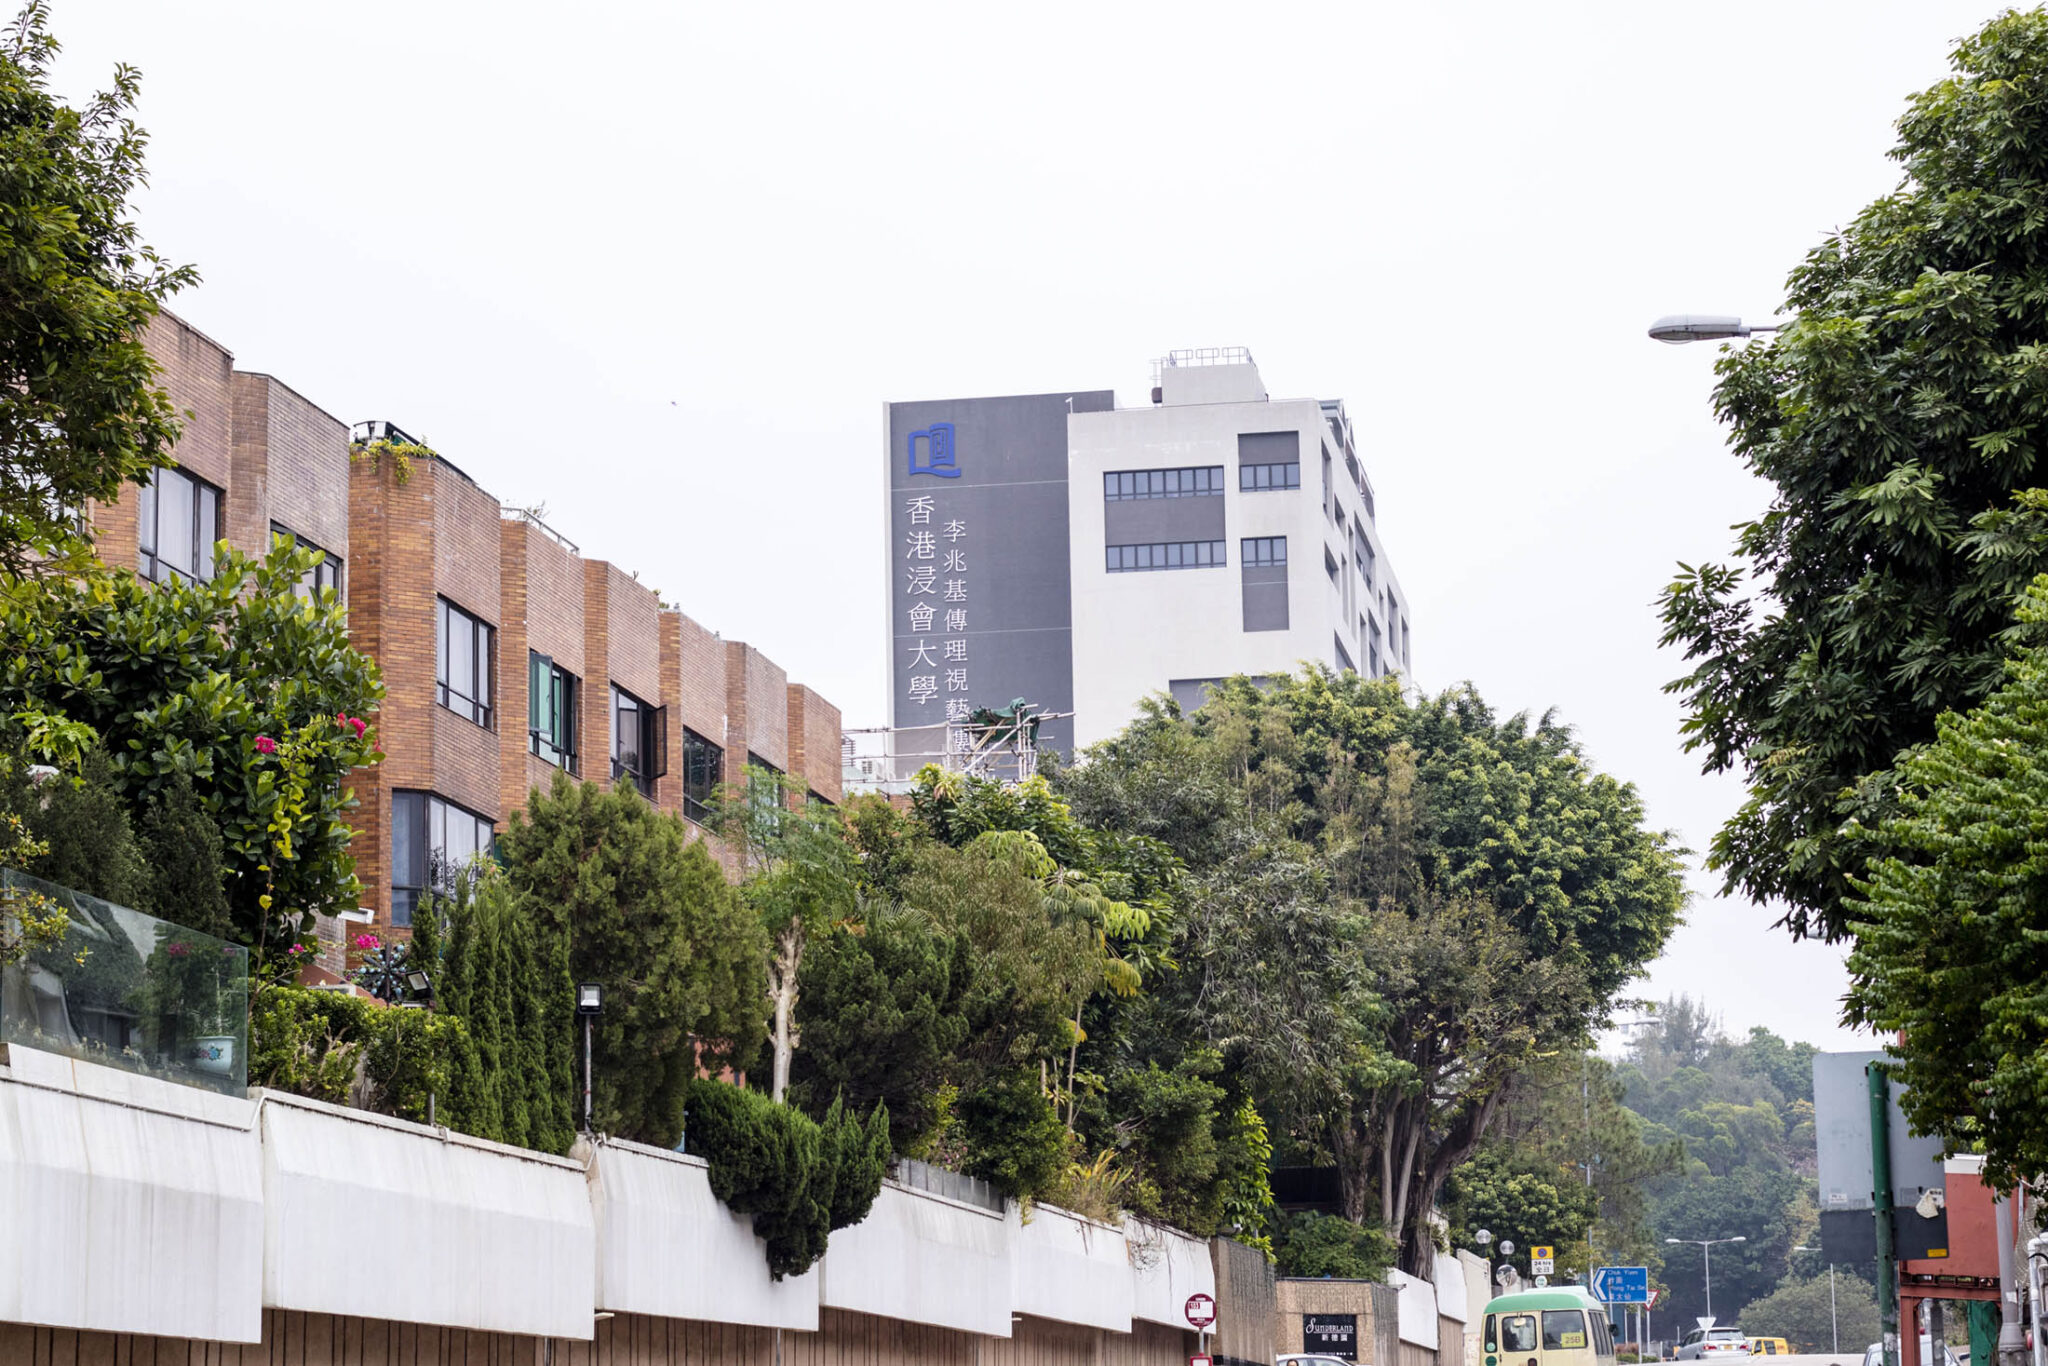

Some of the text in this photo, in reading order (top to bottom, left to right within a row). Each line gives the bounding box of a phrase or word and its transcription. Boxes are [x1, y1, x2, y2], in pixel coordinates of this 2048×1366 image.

[906, 495, 938, 705] 香港浸會大學
